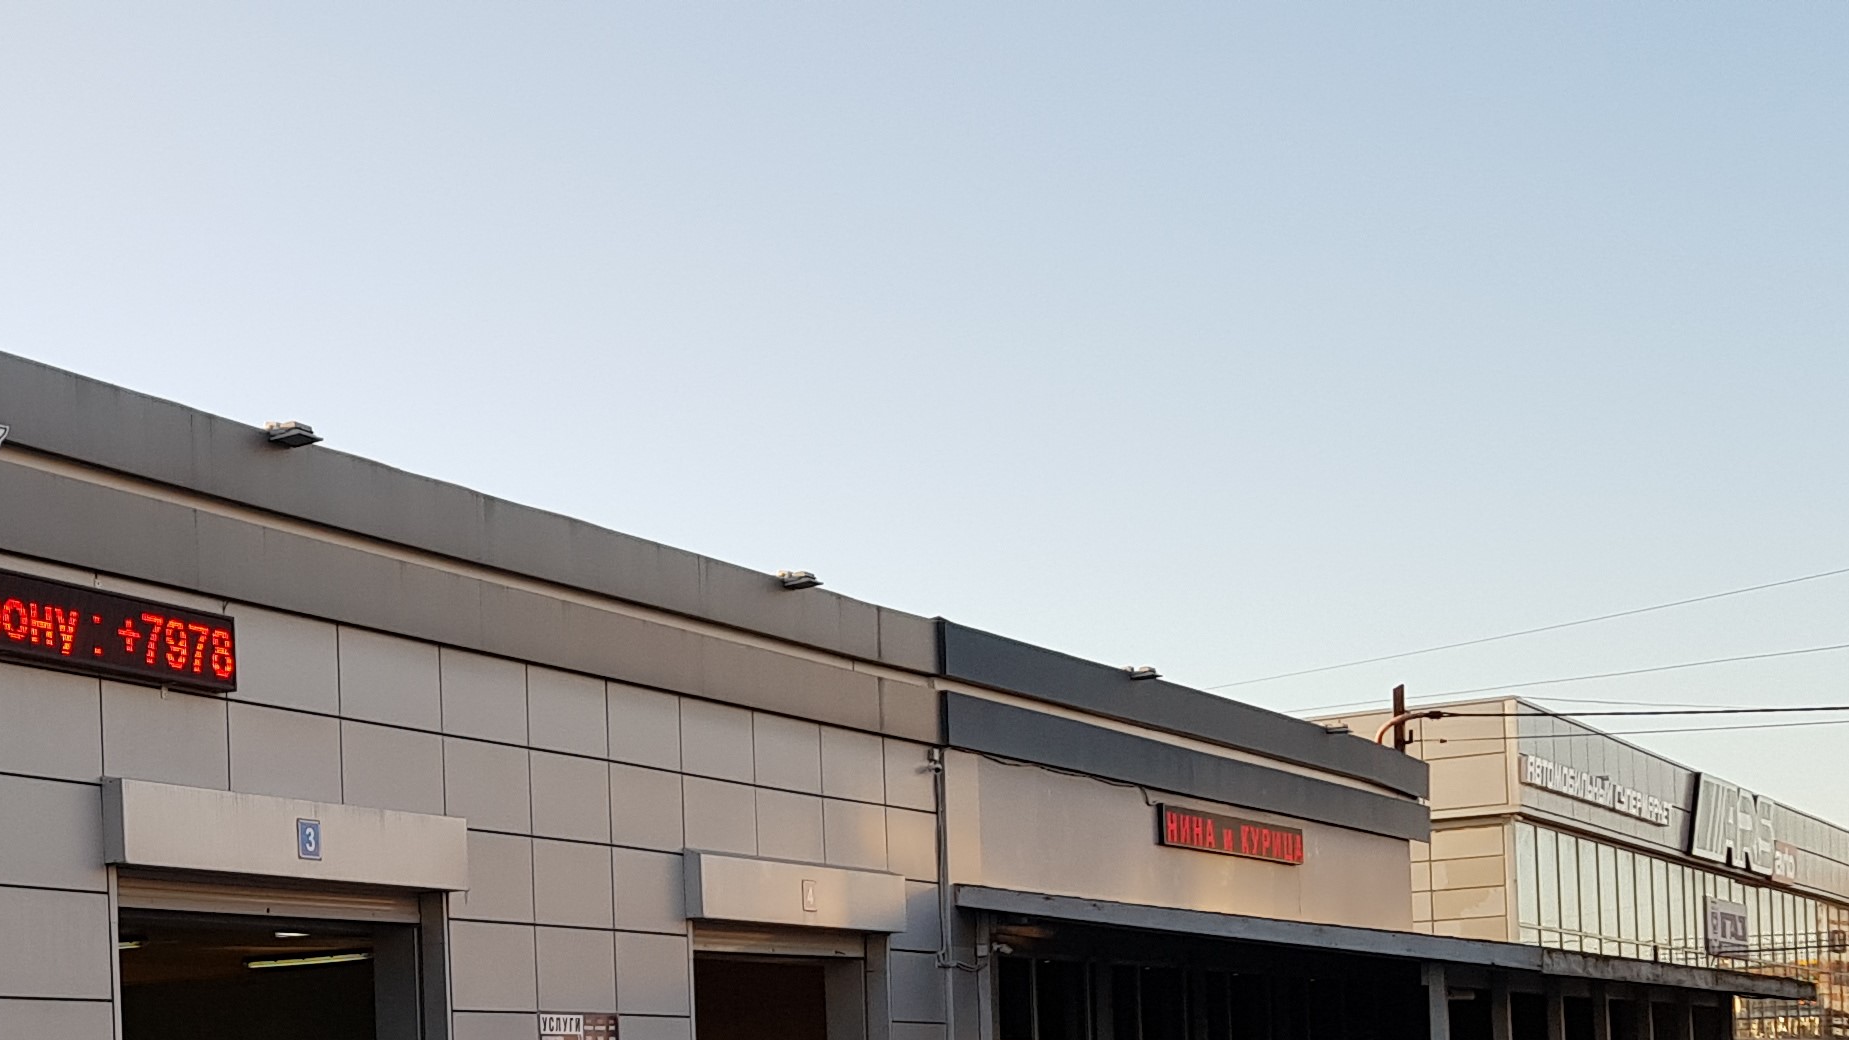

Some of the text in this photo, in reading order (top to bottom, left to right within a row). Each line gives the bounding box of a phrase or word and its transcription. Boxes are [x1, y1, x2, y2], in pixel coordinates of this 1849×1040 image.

[117, 612, 234, 679] +7978
[305, 827, 316, 852] 3
[1166, 811, 1216, 848] НИНА
[1240, 825, 1304, 864] КУРИЦА
[541, 1016, 581, 1032] УСЛУГИ
